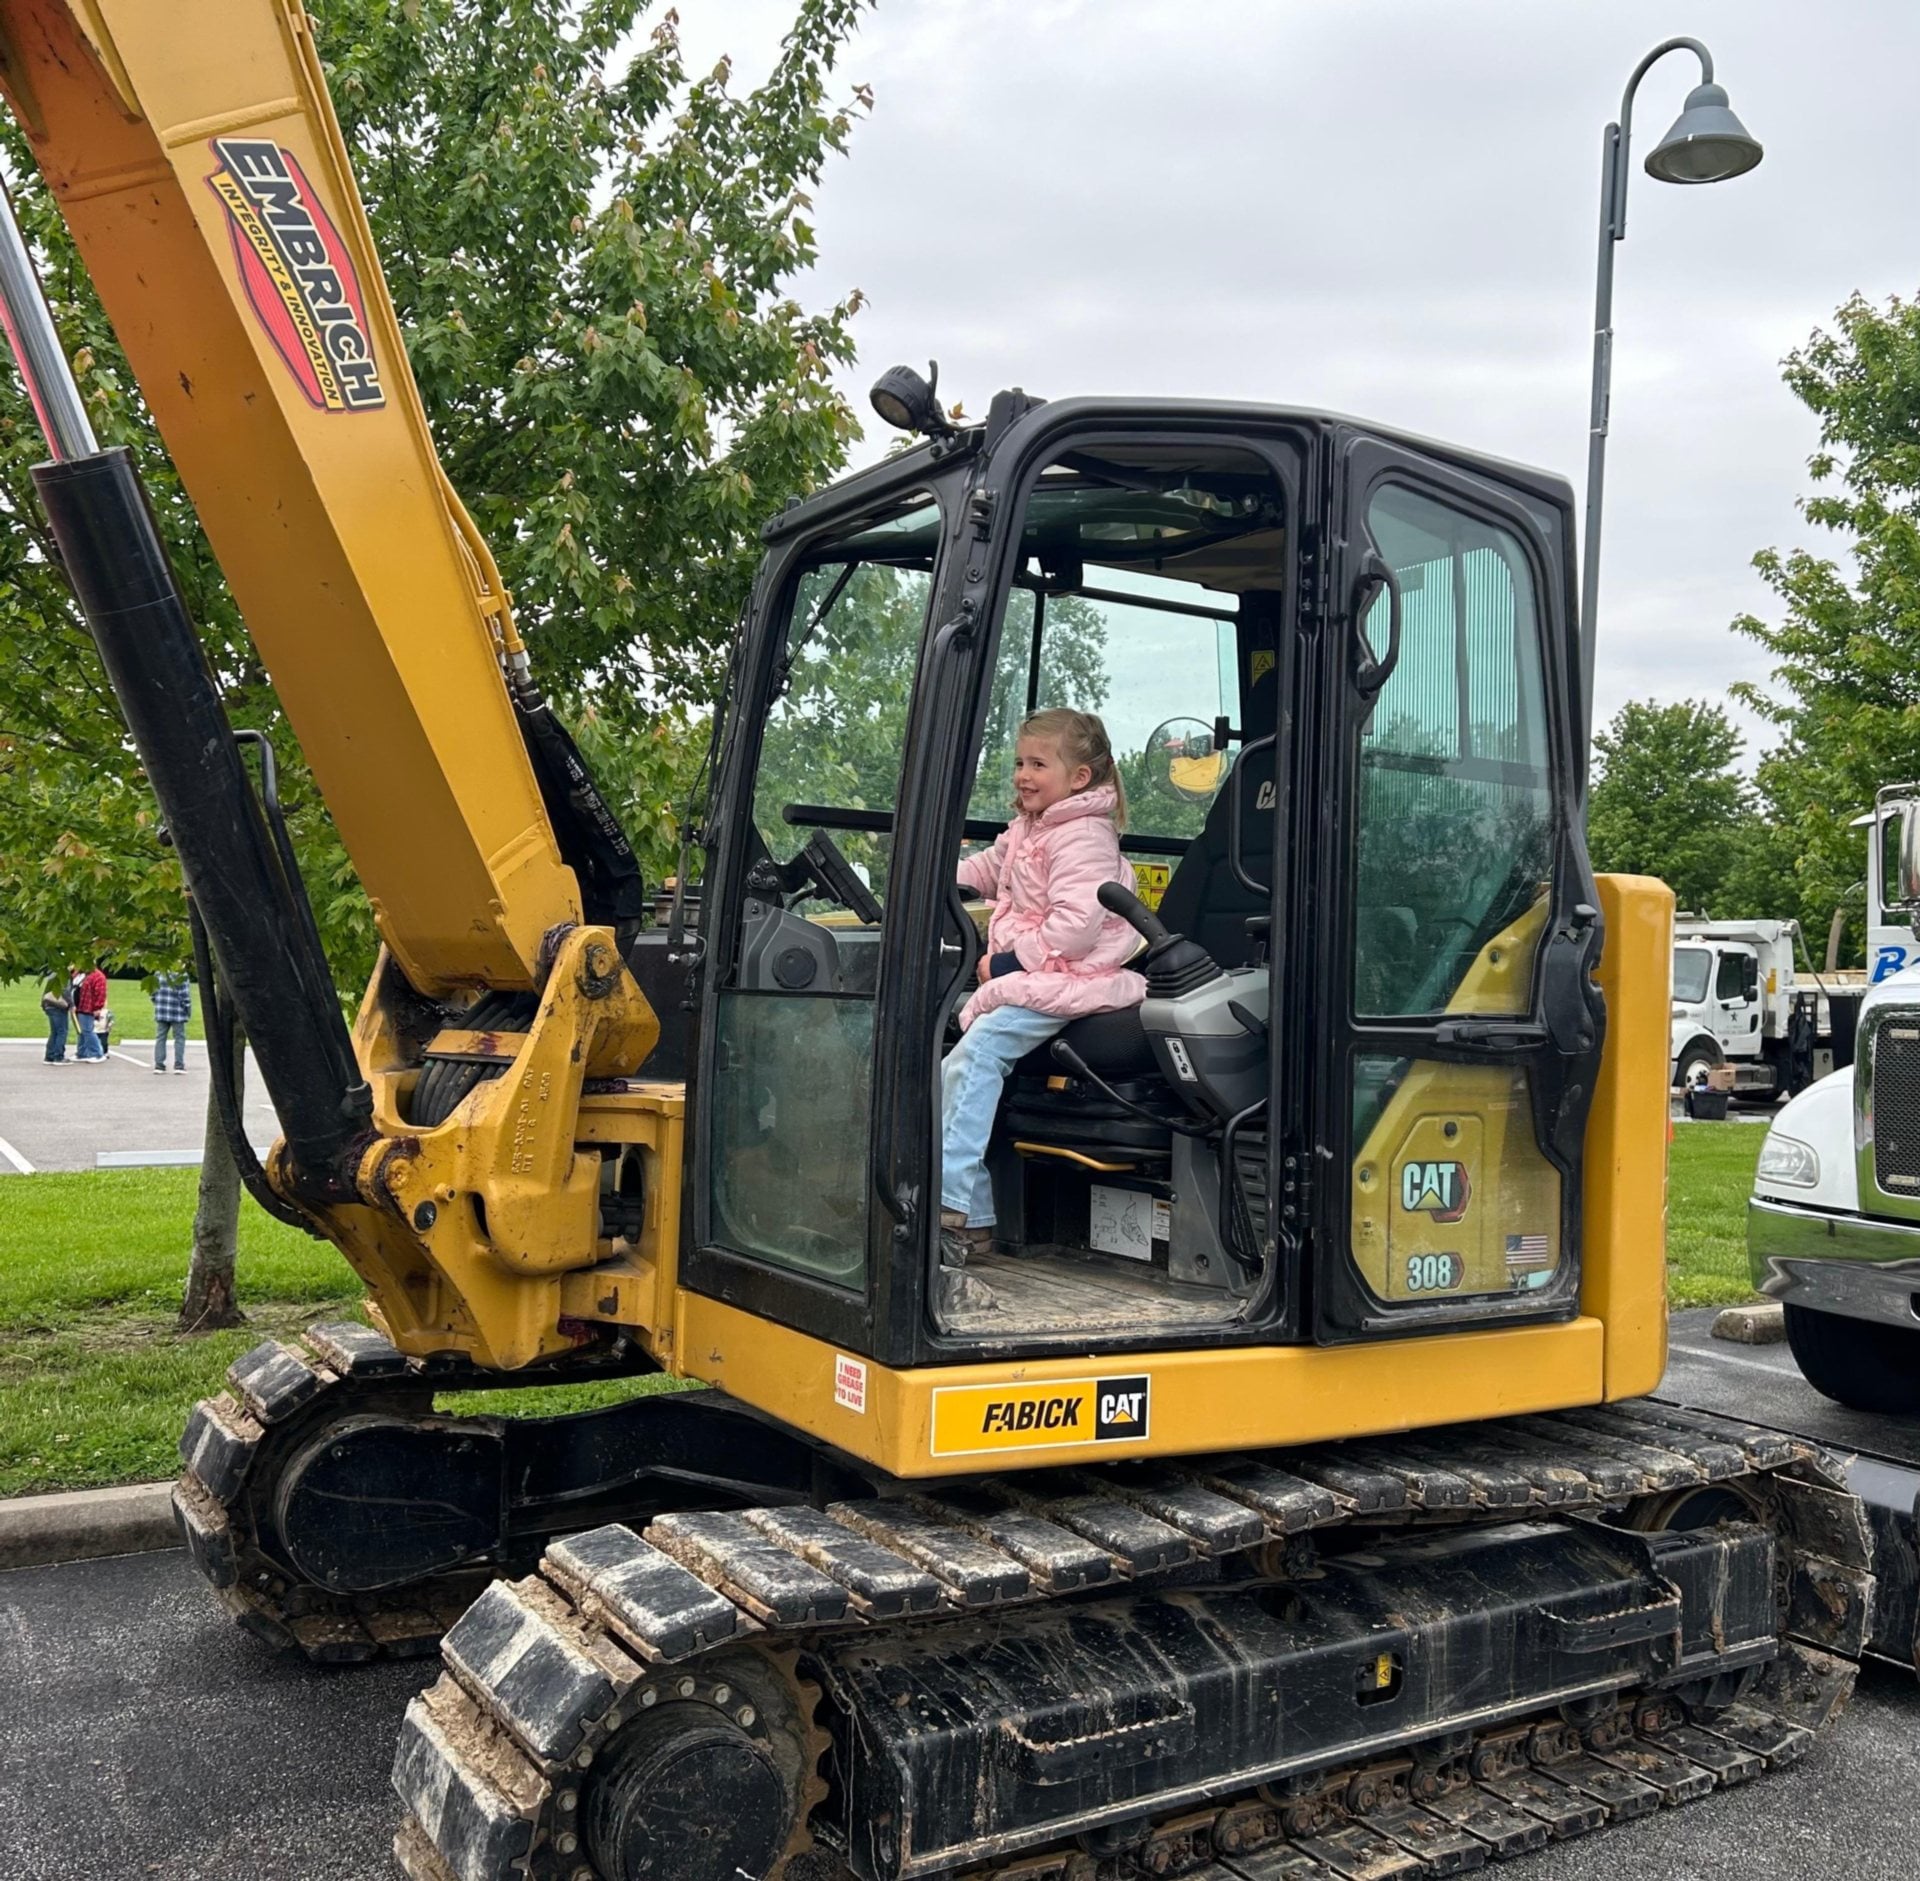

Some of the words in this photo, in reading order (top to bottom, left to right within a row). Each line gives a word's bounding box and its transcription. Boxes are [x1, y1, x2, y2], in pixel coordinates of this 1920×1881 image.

[214, 138, 386, 408] EMBRICH
[218, 181, 285, 276] INTEGRITY
[279, 279, 291, 291] &
[286, 296, 339, 401] INNOVATION
[1402, 1163, 1456, 1210] CAT
[1408, 1254, 1452, 1291] 308
[837, 1373, 863, 1393] GREASE
[844, 1363, 862, 1380] NEED
[837, 1387, 846, 1400] TO
[847, 1391, 862, 1407] LIVE
[982, 1397, 1084, 1433] FABICK
[1101, 1392, 1143, 1424] CAT
